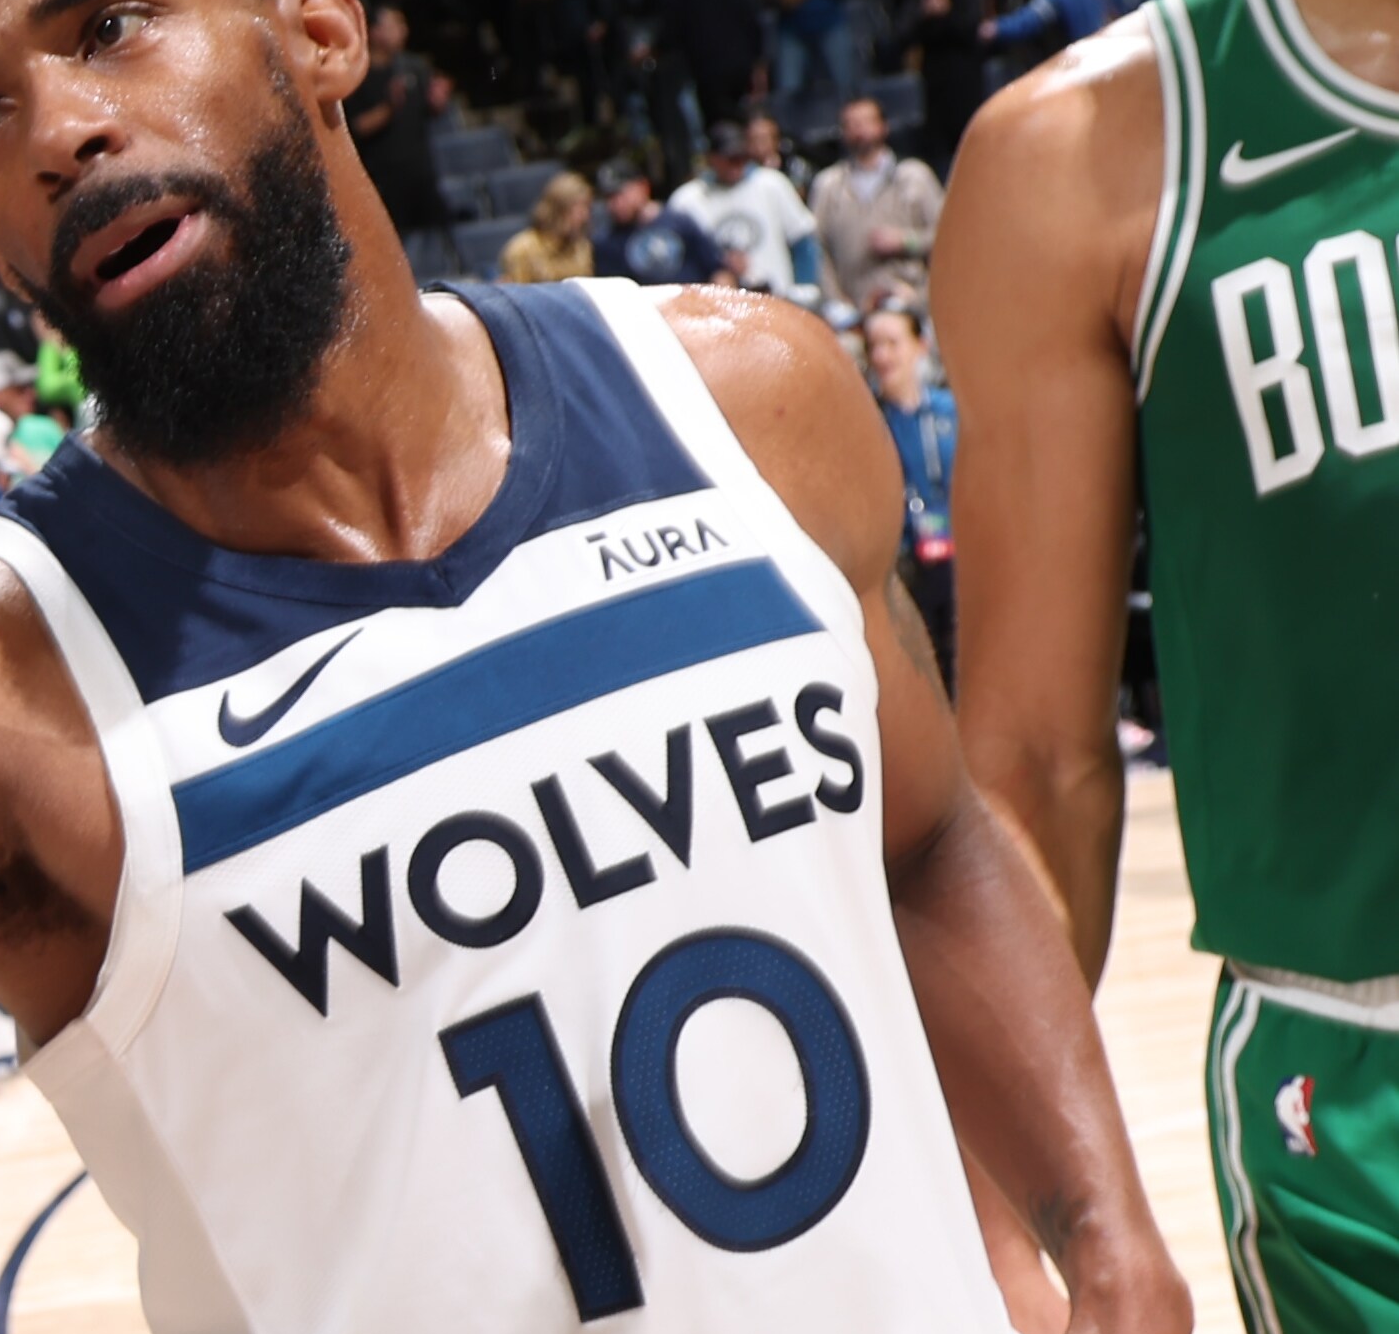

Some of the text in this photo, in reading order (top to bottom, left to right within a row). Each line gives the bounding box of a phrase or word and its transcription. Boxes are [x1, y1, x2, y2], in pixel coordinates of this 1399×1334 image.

[1211, 229, 1399, 496] BO
[223, 680, 865, 1019] WOLVES
[437, 924, 872, 1324] 10
